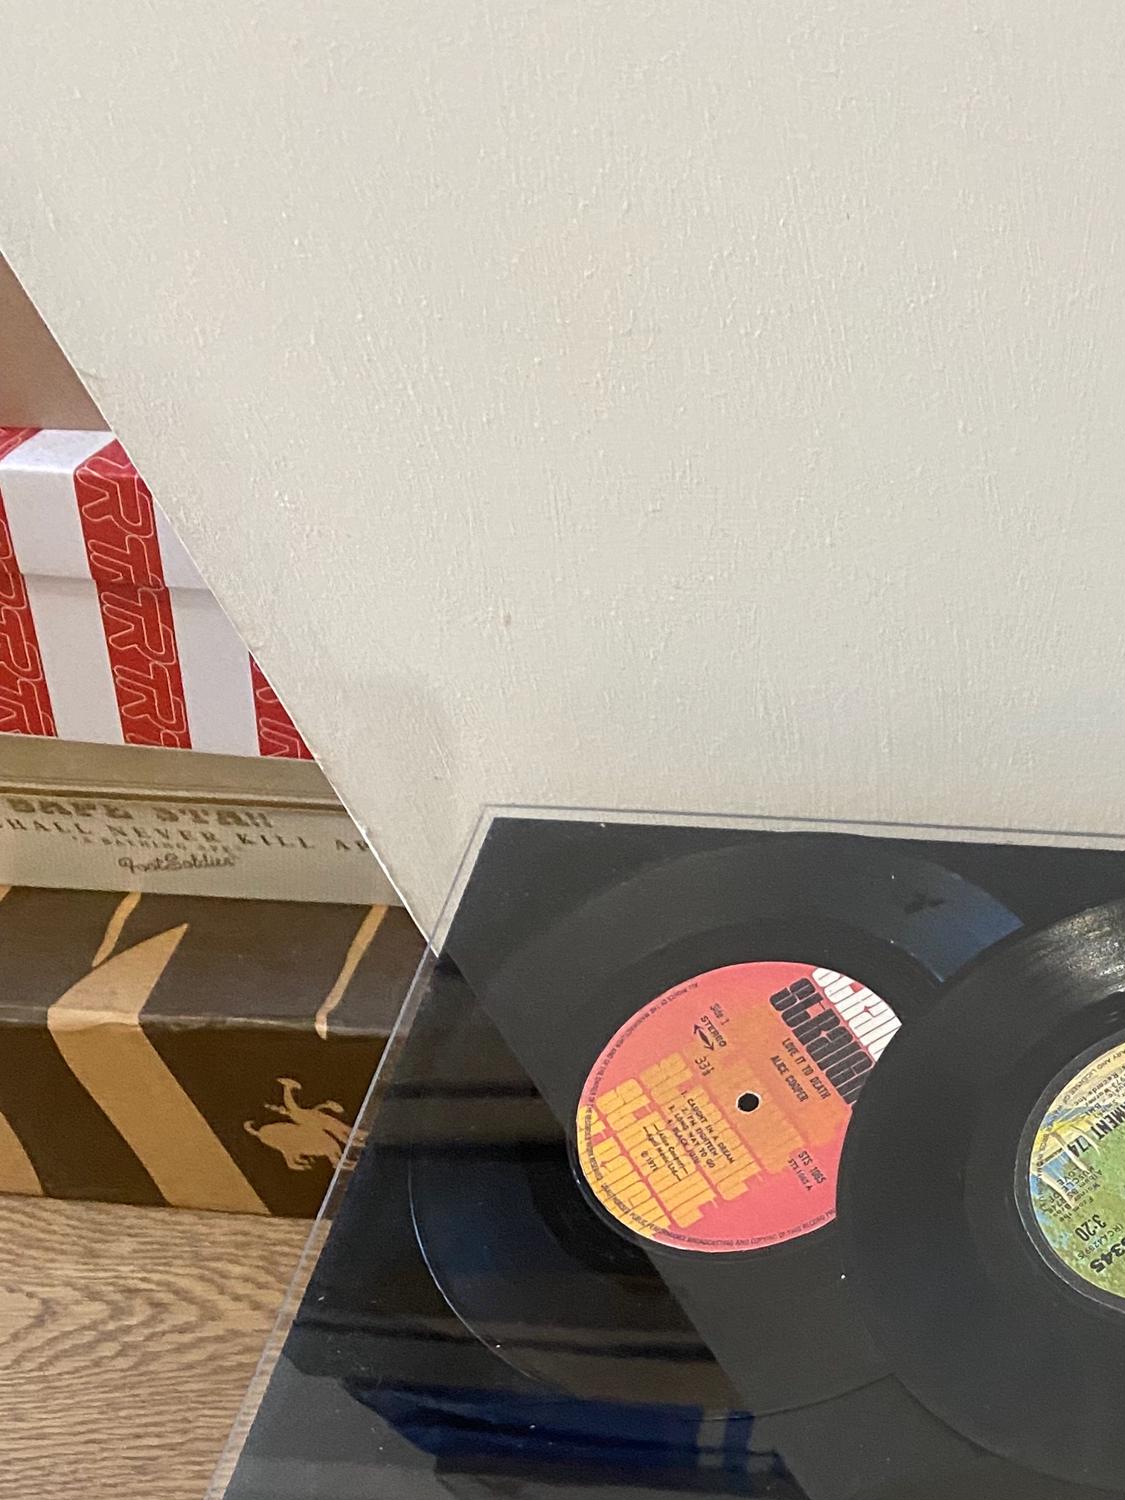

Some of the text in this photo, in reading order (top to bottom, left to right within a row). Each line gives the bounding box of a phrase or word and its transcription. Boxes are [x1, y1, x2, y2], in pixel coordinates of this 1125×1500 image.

[0, 816, 315, 850] HALL NEVER KILL
[699, 1014, 727, 1048] STEREO
[770, 1054, 808, 1102] ALICE COOPER
[781, 1038, 799, 1056] LOVE
[808, 1077, 830, 1100] DEATH
[673, 1113, 689, 1130] LONG
[687, 1132, 700, 1146] WAY
[686, 1098, 707, 1123] CAUGHT
[716, 1142, 735, 1163] DREAM
[695, 1127, 719, 1156] EIGHTEEN
[796, 1150, 826, 1184] STS 1065
[1055, 1165, 1081, 1186] LOVE
[1060, 1165, 1095, 1192] MUSCLE
[1073, 1213, 1107, 1243] 3:20
